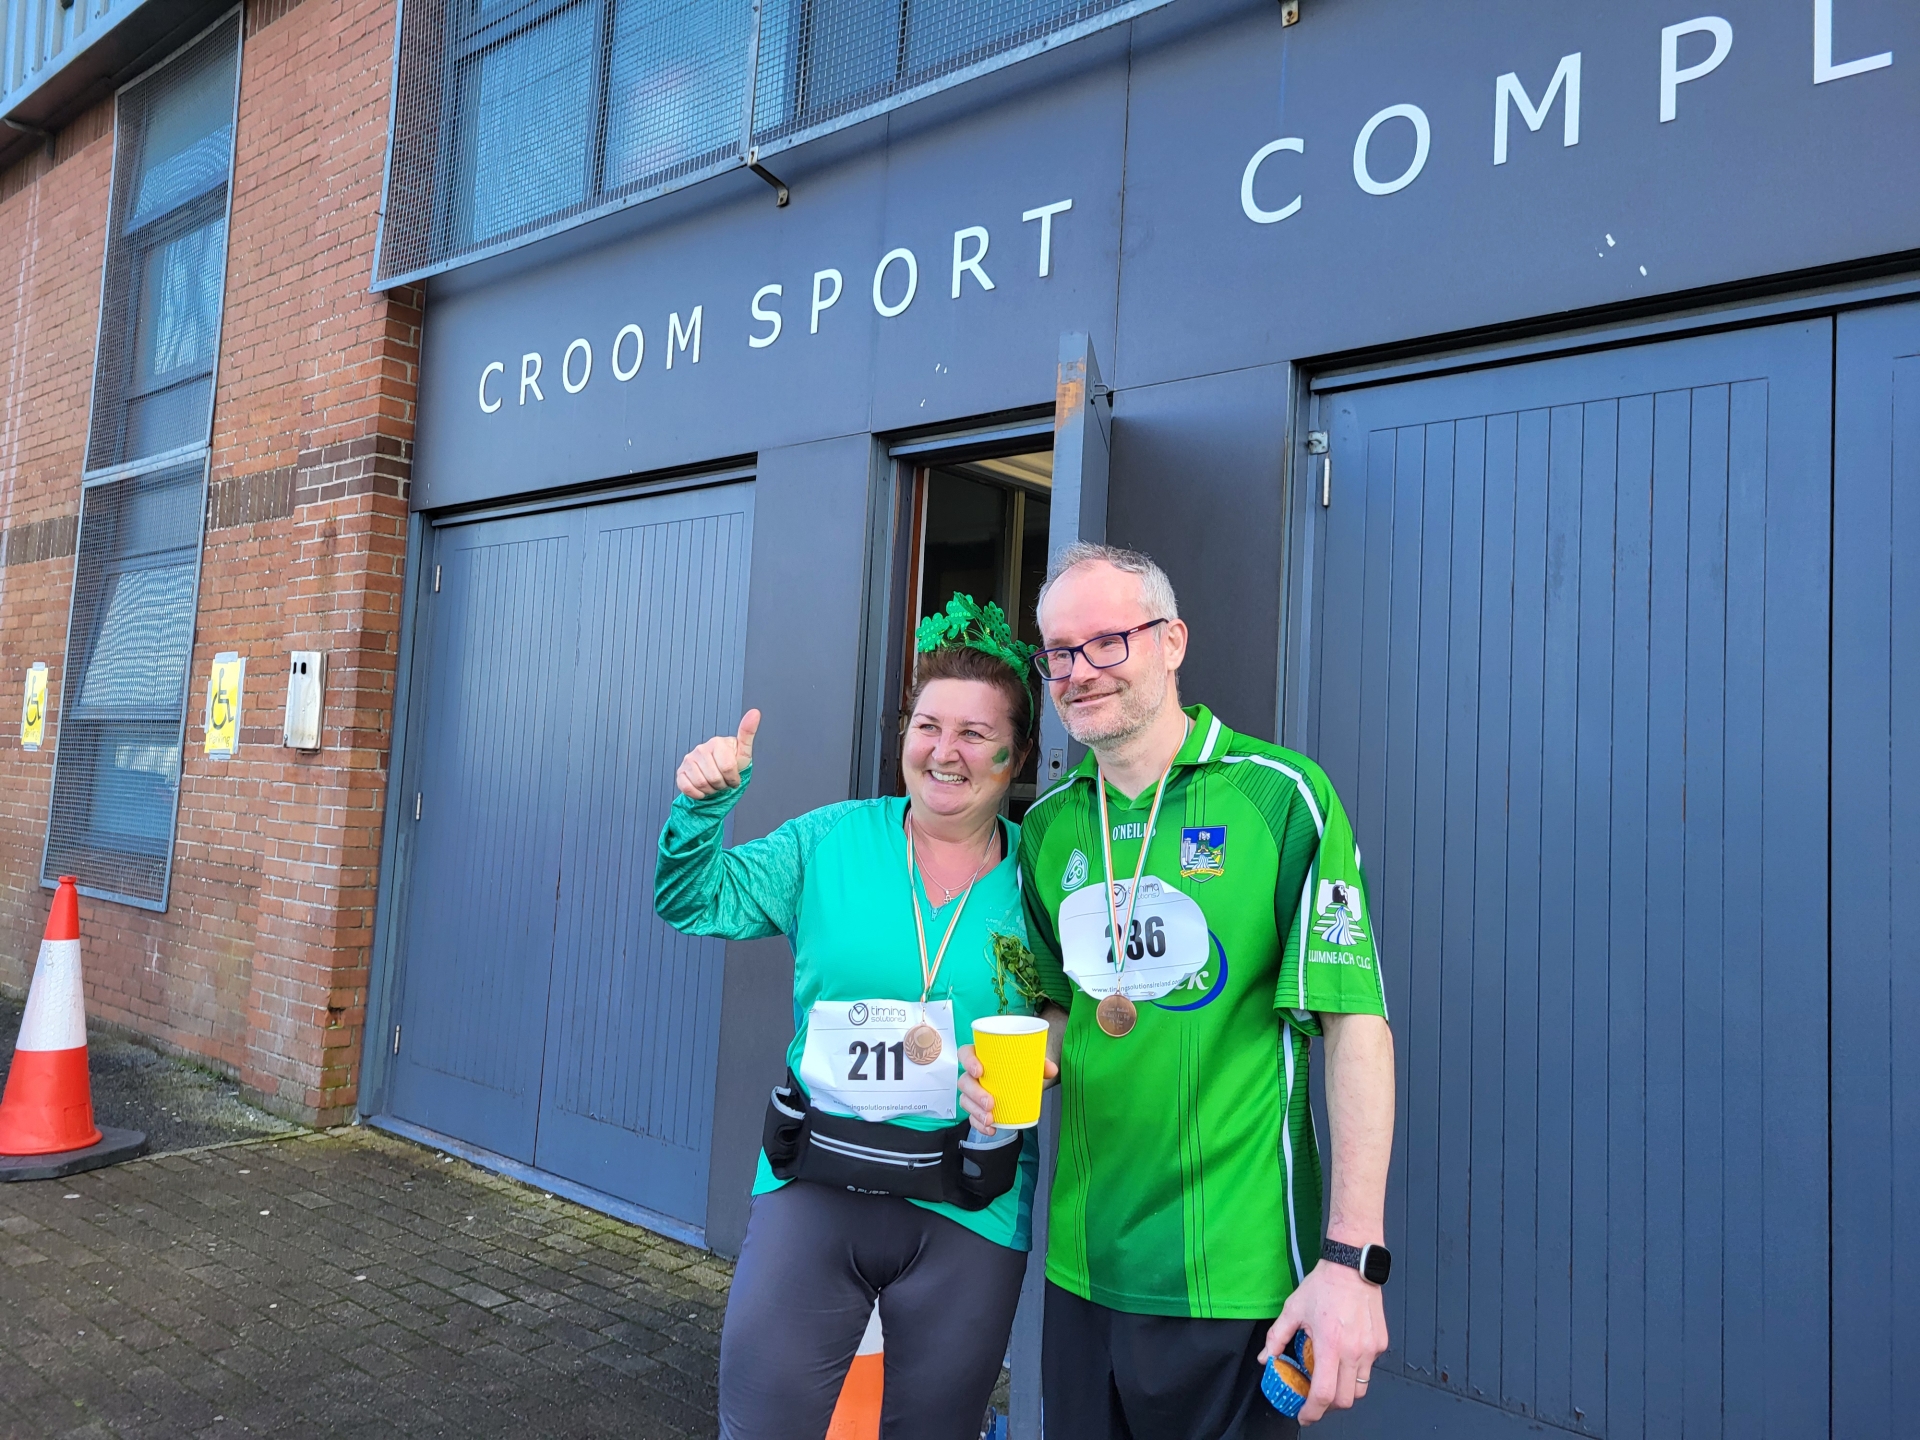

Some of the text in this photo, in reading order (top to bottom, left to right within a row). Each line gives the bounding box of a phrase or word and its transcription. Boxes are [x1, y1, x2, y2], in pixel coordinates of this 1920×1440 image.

[478, 0, 1892, 414] CROOM SPORT COMPL
[1112, 822, 1157, 841] O'NEILL
[1104, 915, 1167, 964] 236
[1309, 950, 1355, 965] LUIMNEACH
[870, 1005, 907, 1023] timing
[847, 1040, 904, 1081] 211
